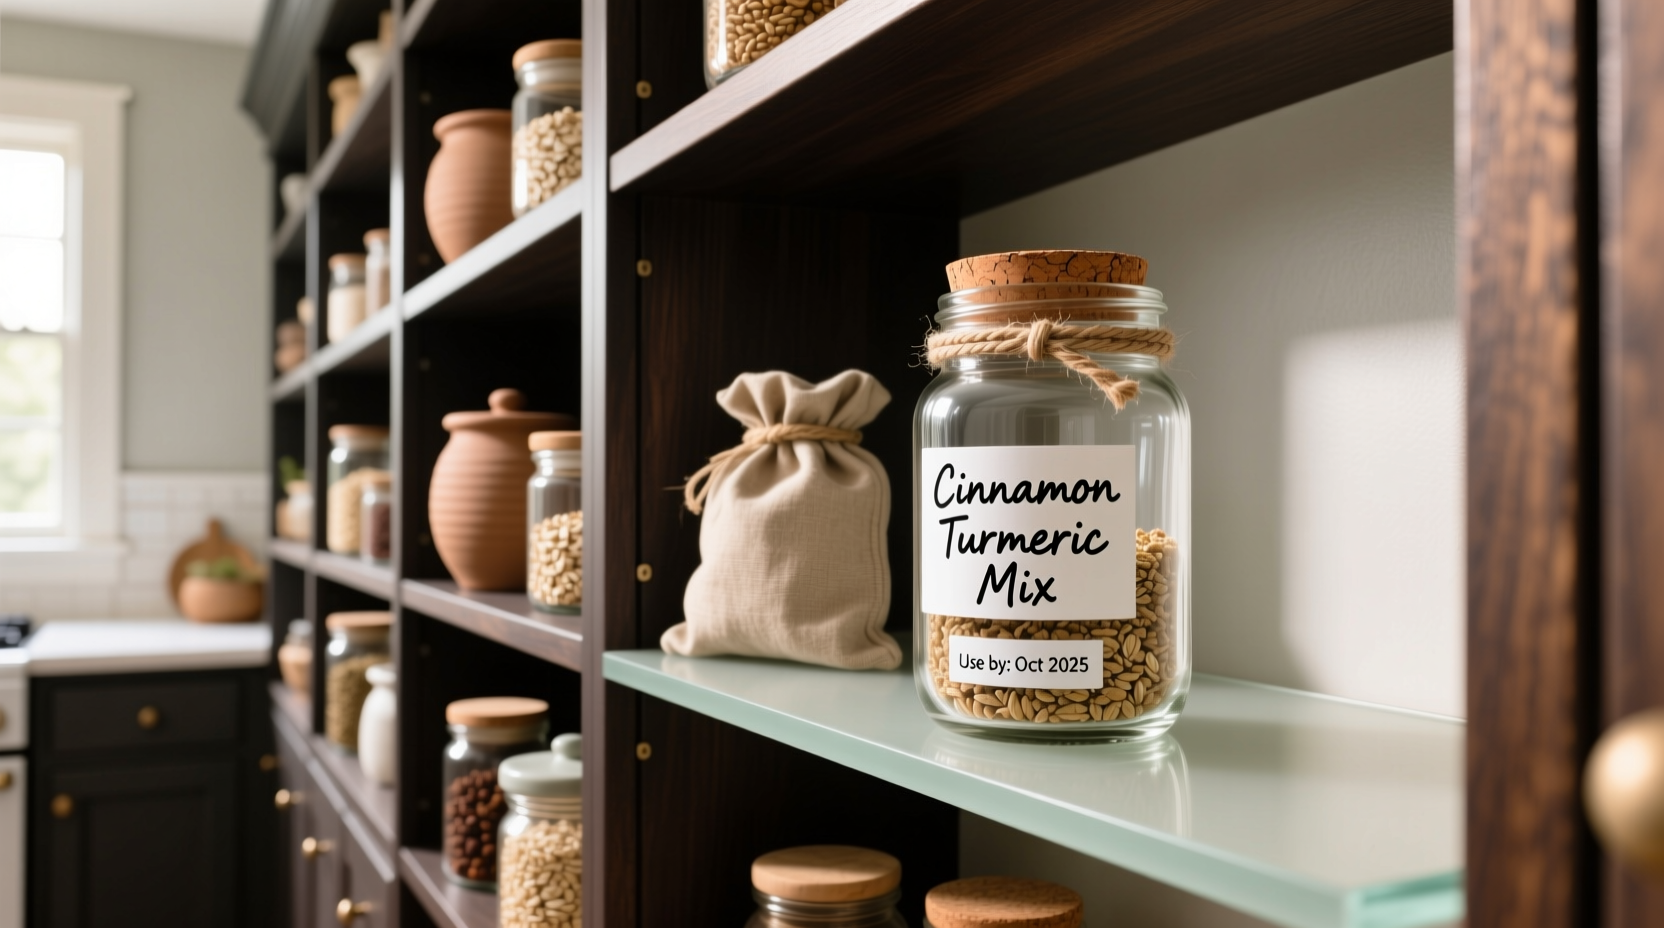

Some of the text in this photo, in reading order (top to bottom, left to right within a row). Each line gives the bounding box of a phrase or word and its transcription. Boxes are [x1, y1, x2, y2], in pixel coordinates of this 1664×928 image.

[934, 463, 1121, 509] Cinnamon
[939, 514, 1109, 559] Turmeric
[976, 561, 1057, 608] Mix
[959, 653, 1089, 676] Use by: Oct 2025
